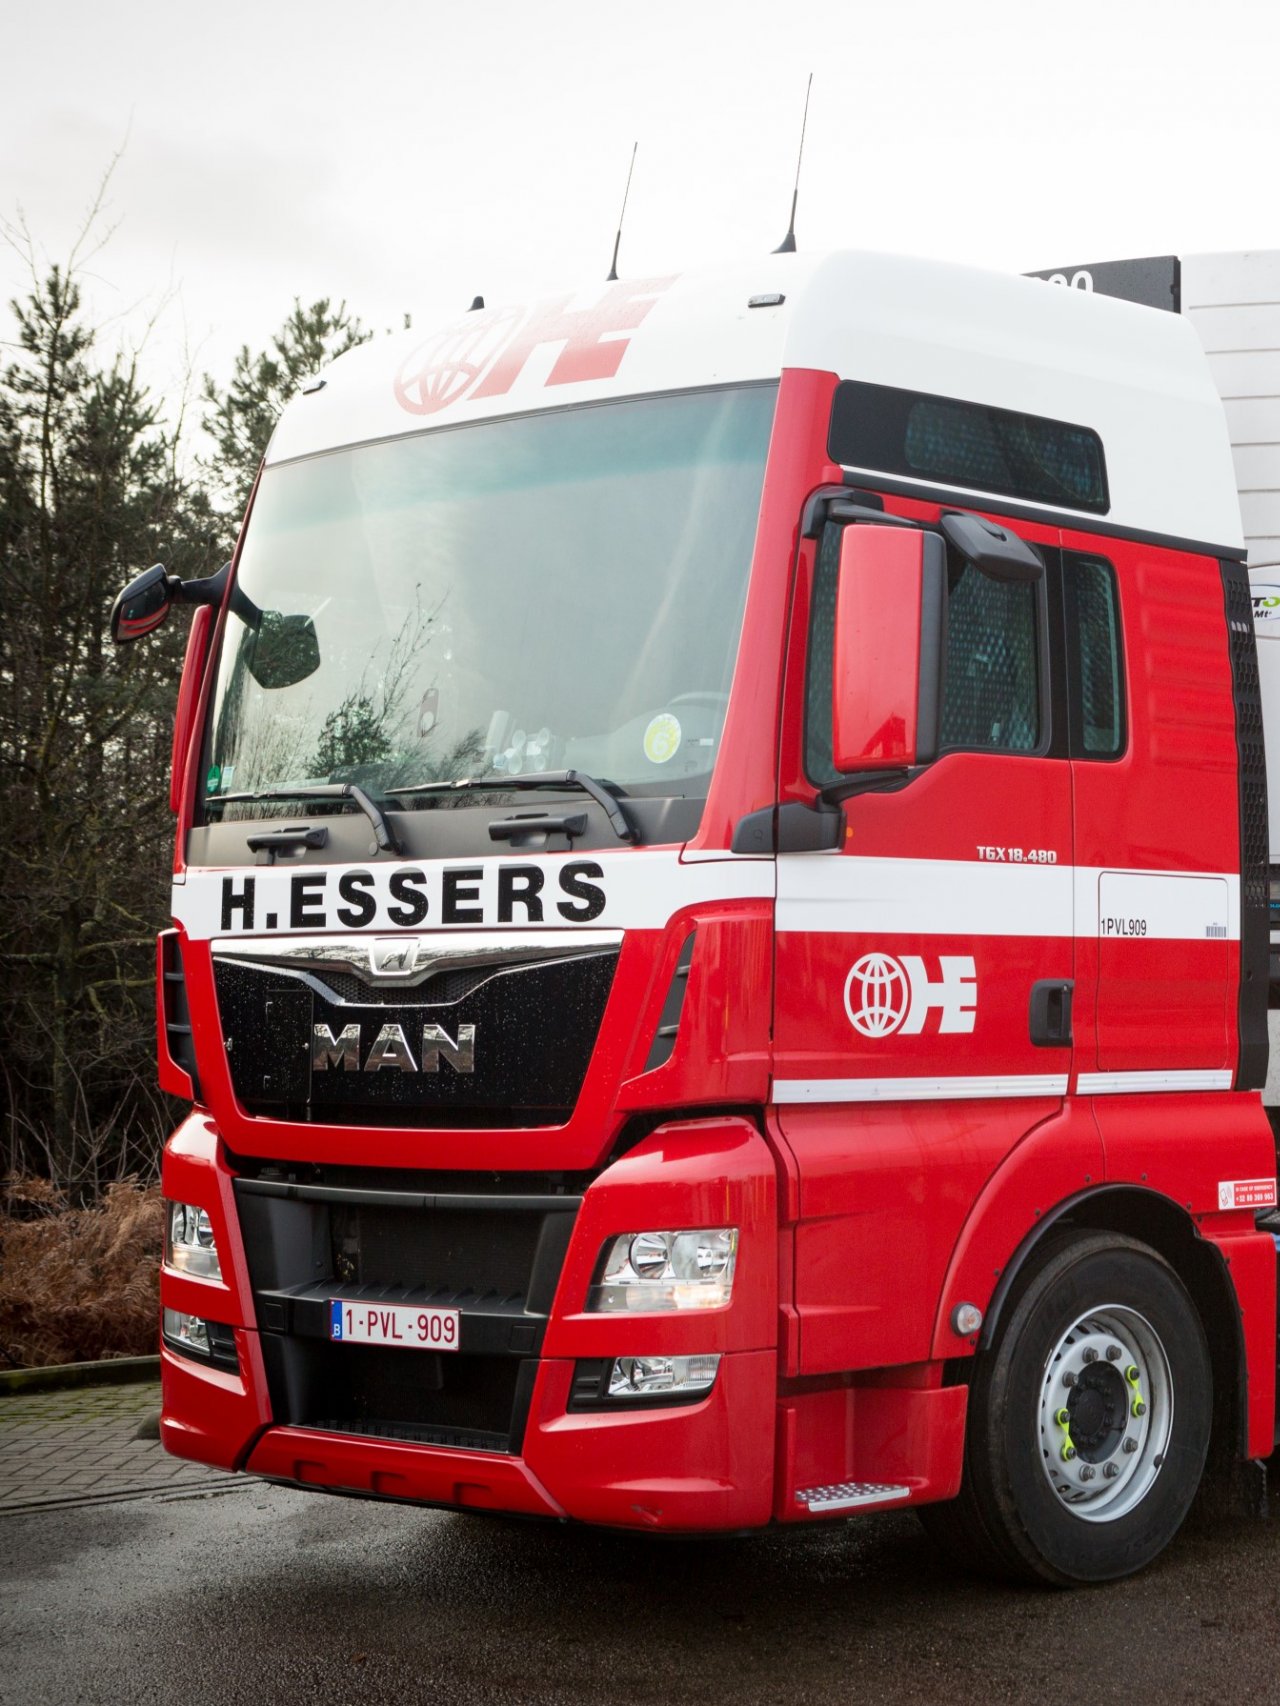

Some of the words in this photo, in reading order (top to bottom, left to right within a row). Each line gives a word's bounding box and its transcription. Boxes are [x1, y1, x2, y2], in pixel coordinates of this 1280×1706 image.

[976, 846, 1006, 861] TGX
[1007, 847, 1057, 864] 18.480
[220, 859, 607, 931] H.ESSERS
[1101, 917, 1147, 936] 1PVL909
[313, 1023, 476, 1074] MAN
[333, 1323, 341, 1336] B
[346, 1309, 455, 1343] 1-PVL-909
